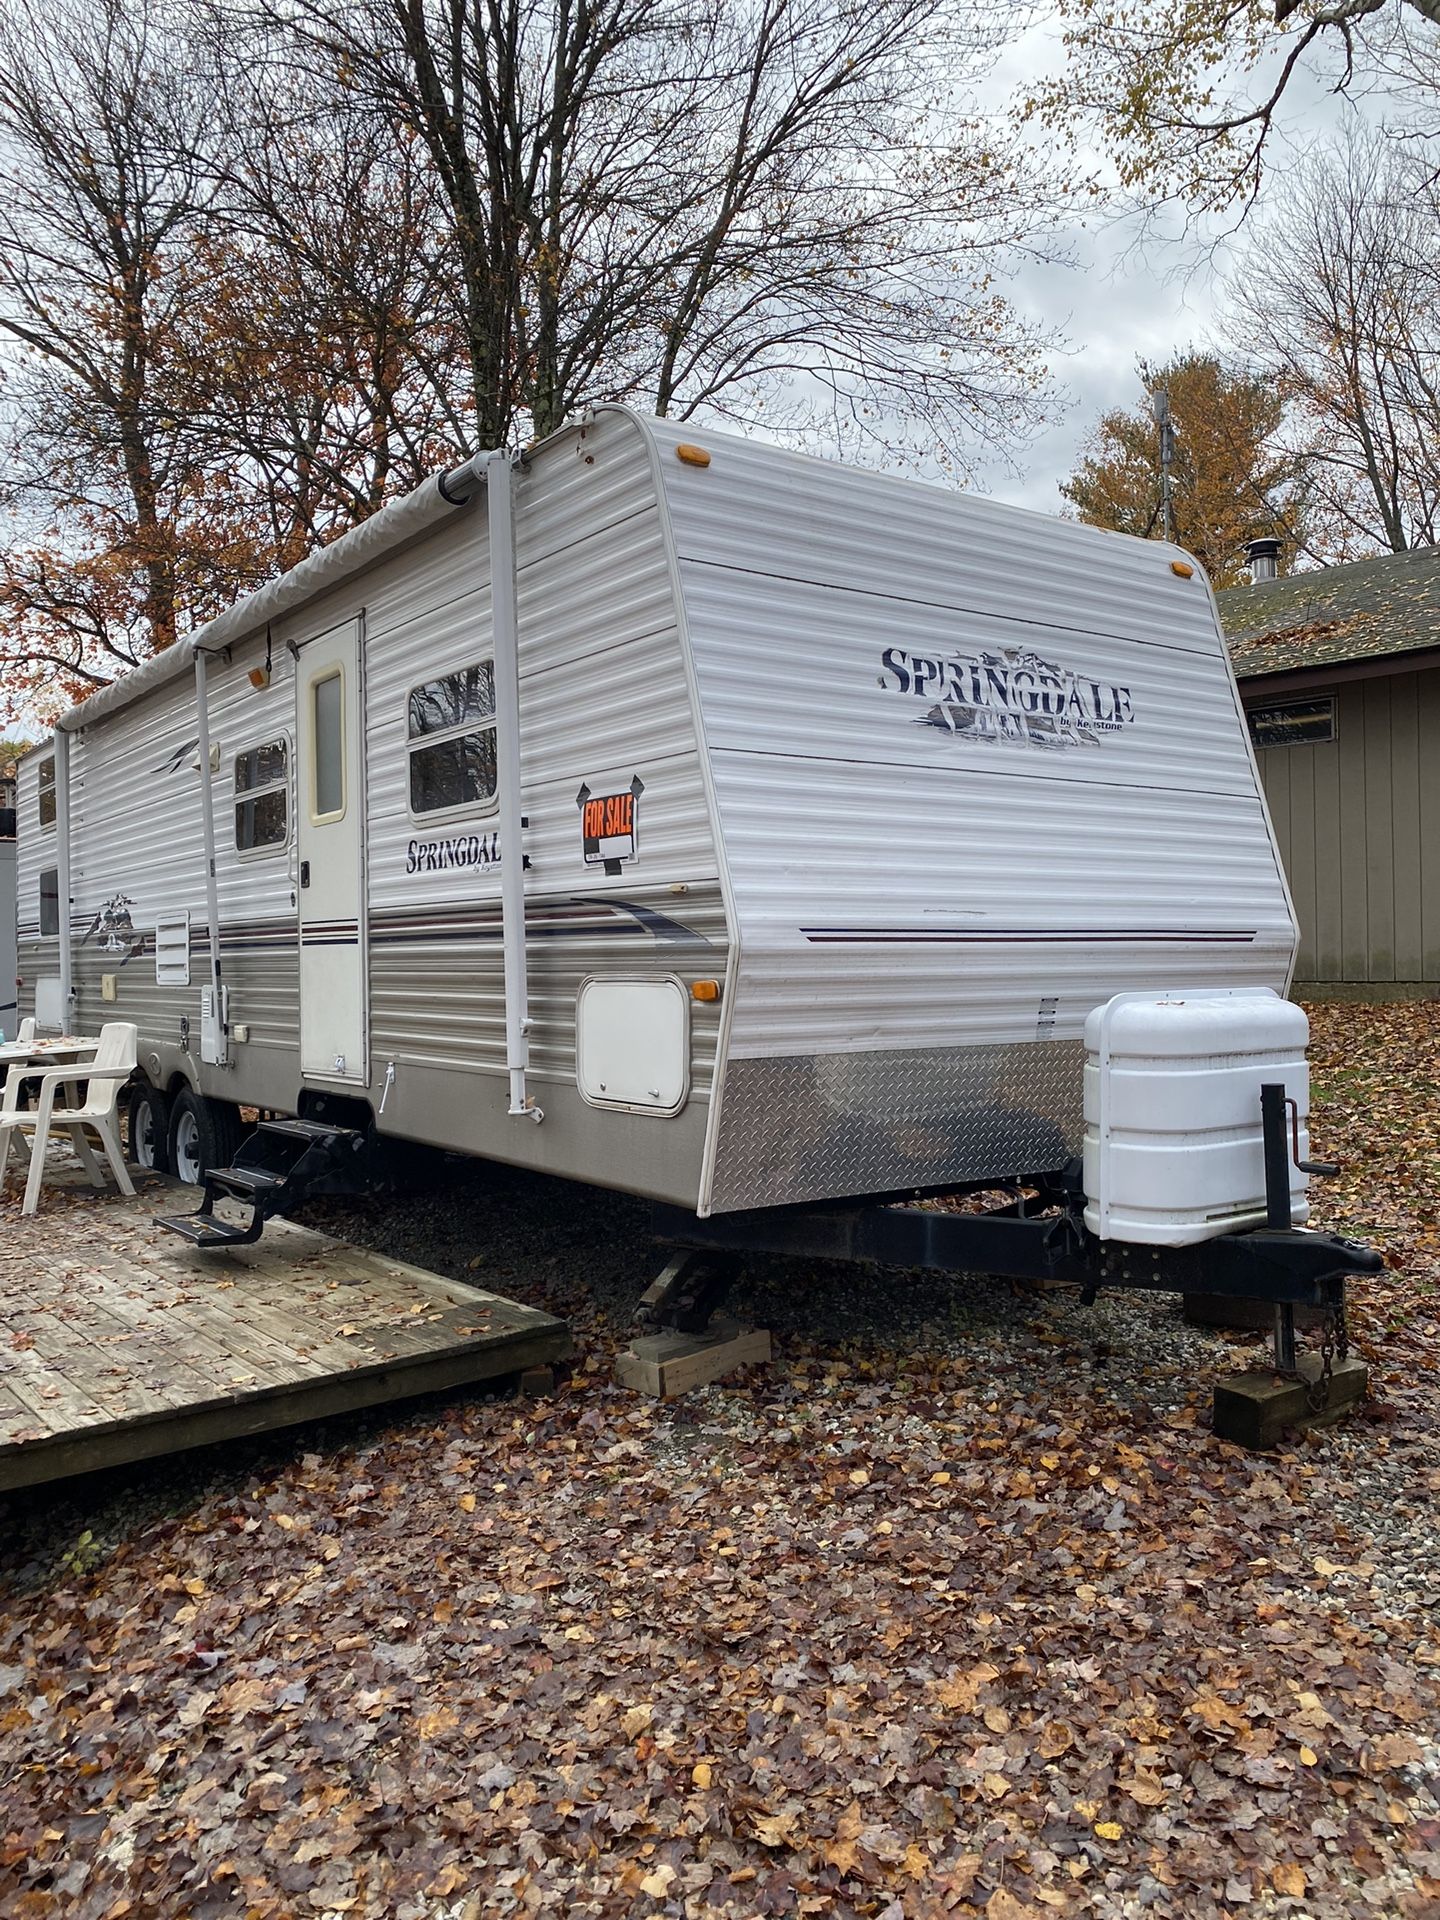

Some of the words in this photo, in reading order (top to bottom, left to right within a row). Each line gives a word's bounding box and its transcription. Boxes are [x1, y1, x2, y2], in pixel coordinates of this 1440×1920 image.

[877, 647, 1135, 723] SPRINGDALE
[585, 800, 604, 838] FOR
[606, 795, 633, 834] SALE
[406, 832, 501, 873] SPRINGDAL
